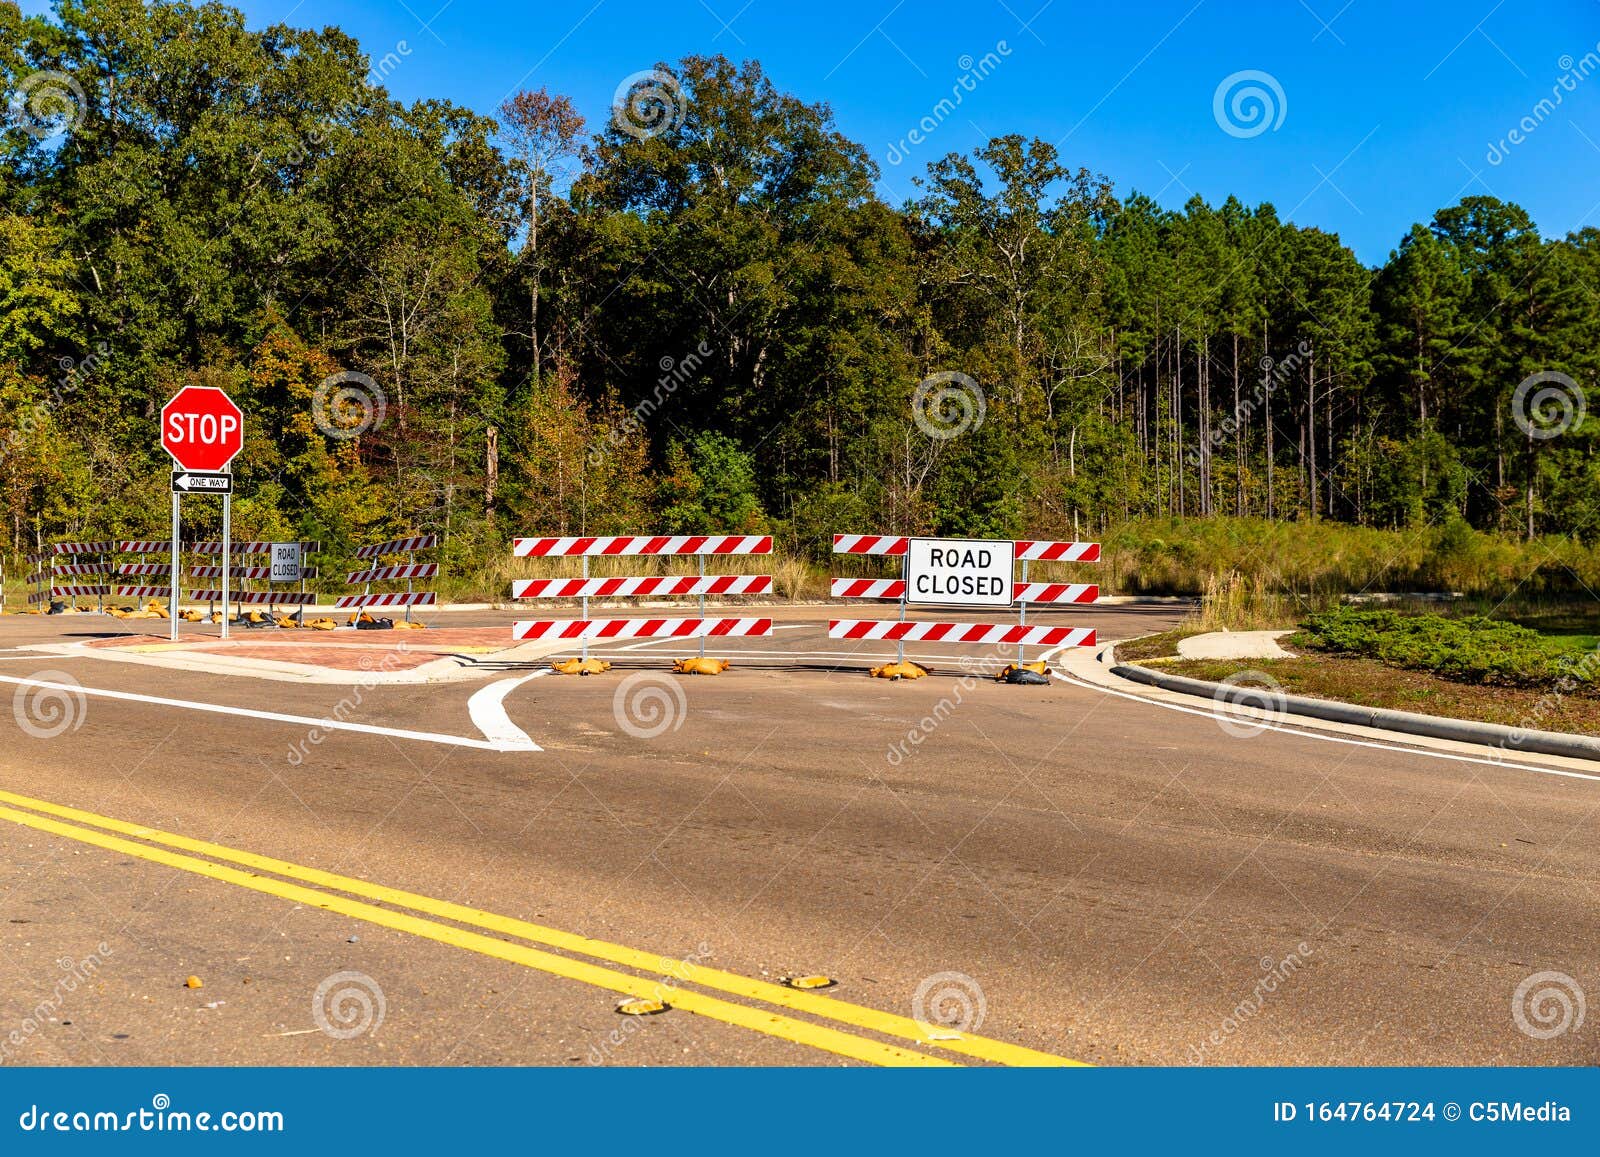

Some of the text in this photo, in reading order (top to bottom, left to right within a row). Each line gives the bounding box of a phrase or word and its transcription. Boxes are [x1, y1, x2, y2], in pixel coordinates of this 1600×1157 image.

[168, 412, 237, 444] STOP
[190, 478, 226, 488] ONE WAY
[278, 548, 295, 560] ROAD
[931, 548, 991, 568] ROAD
[273, 564, 298, 576] CLOSED
[917, 574, 1004, 596] CLOSED
